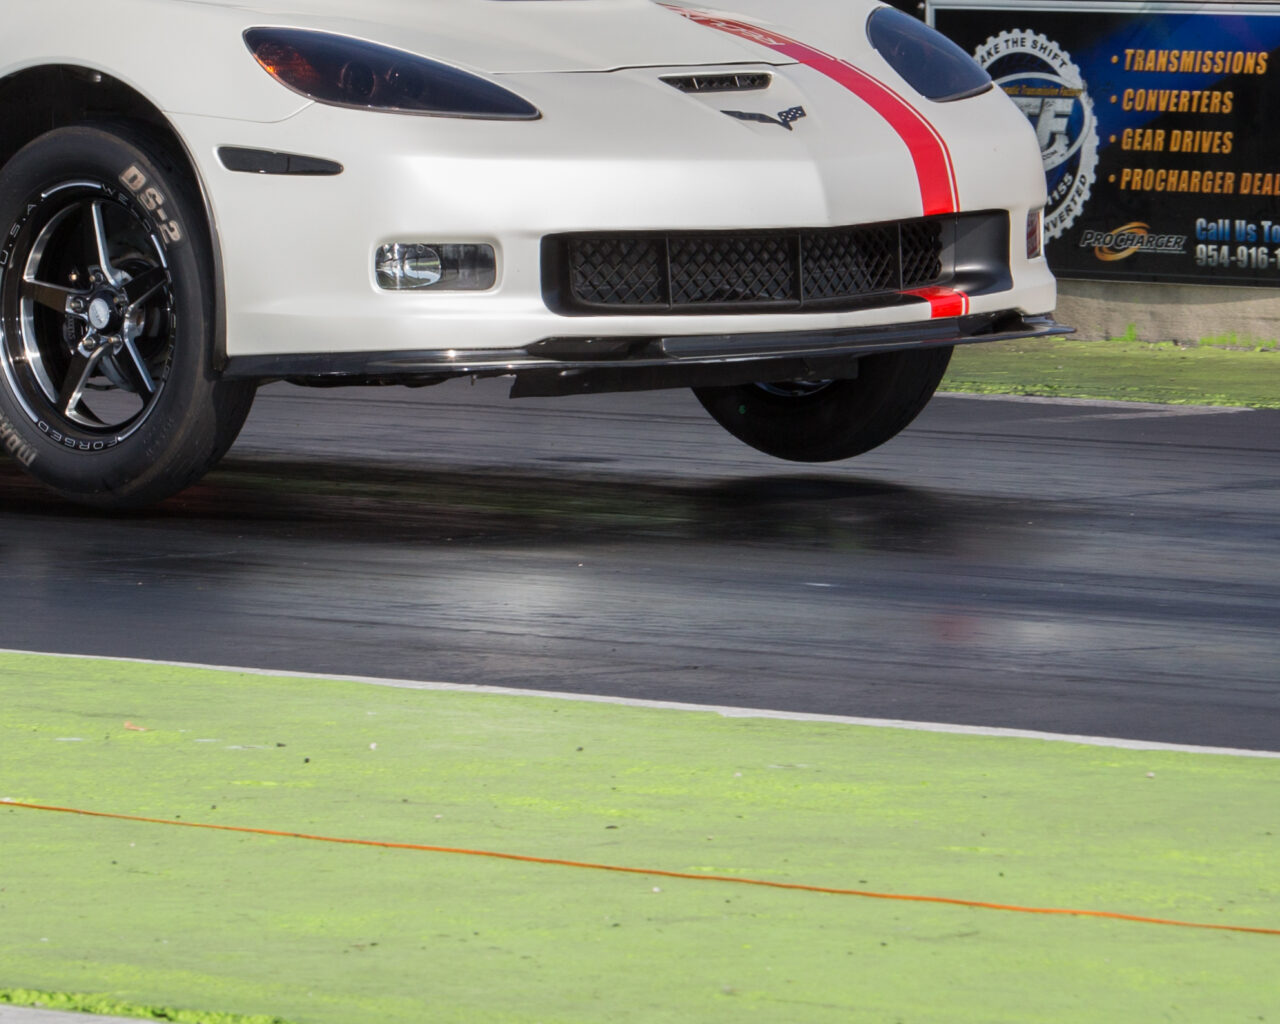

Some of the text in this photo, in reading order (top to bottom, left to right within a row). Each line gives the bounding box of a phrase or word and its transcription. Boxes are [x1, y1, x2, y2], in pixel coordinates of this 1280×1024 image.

[977, 37, 1068, 68] AKE THE SHIFT
[1124, 49, 1268, 74] TRANSMISSIONS
[1122, 89, 1234, 114] CONVERTERS
[1121, 128, 1234, 154] GEAR DRIVES
[1120, 169, 1236, 194] PROCHARGER
[120, 165, 181, 244] DS-2
[1044, 174, 1087, 232] NVERTED
[1195, 218, 1230, 241] Call
[1234, 219, 1257, 243] Us
[37, 420, 120, 450] FORGED
